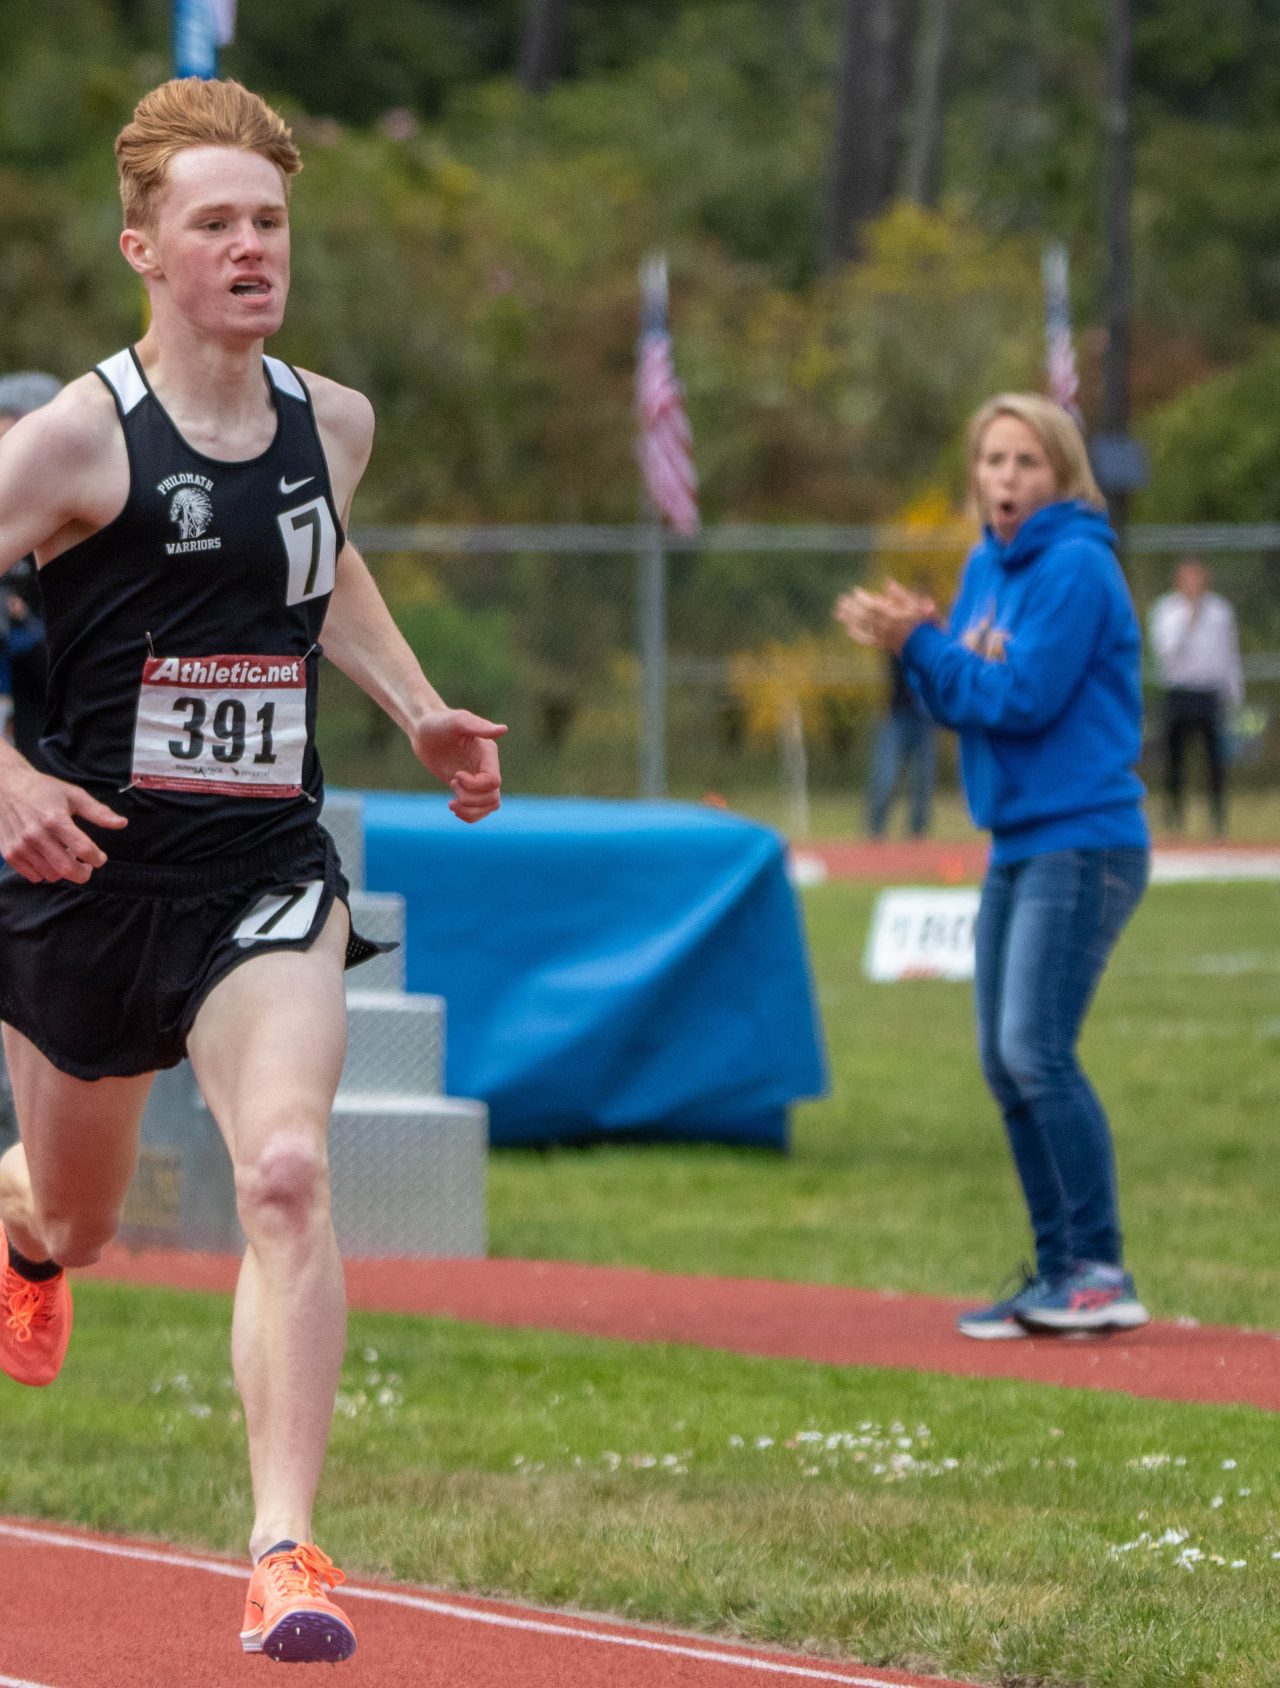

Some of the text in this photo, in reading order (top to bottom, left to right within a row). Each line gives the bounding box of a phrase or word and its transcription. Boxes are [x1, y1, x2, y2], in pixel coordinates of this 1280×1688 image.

[157, 472, 215, 496] PHILOMATH
[165, 537, 222, 555] WARRIORS
[290, 507, 321, 597] 7
[149, 656, 299, 684] Athletic.net
[167, 696, 278, 765] 391
[254, 886, 309, 935] 7
